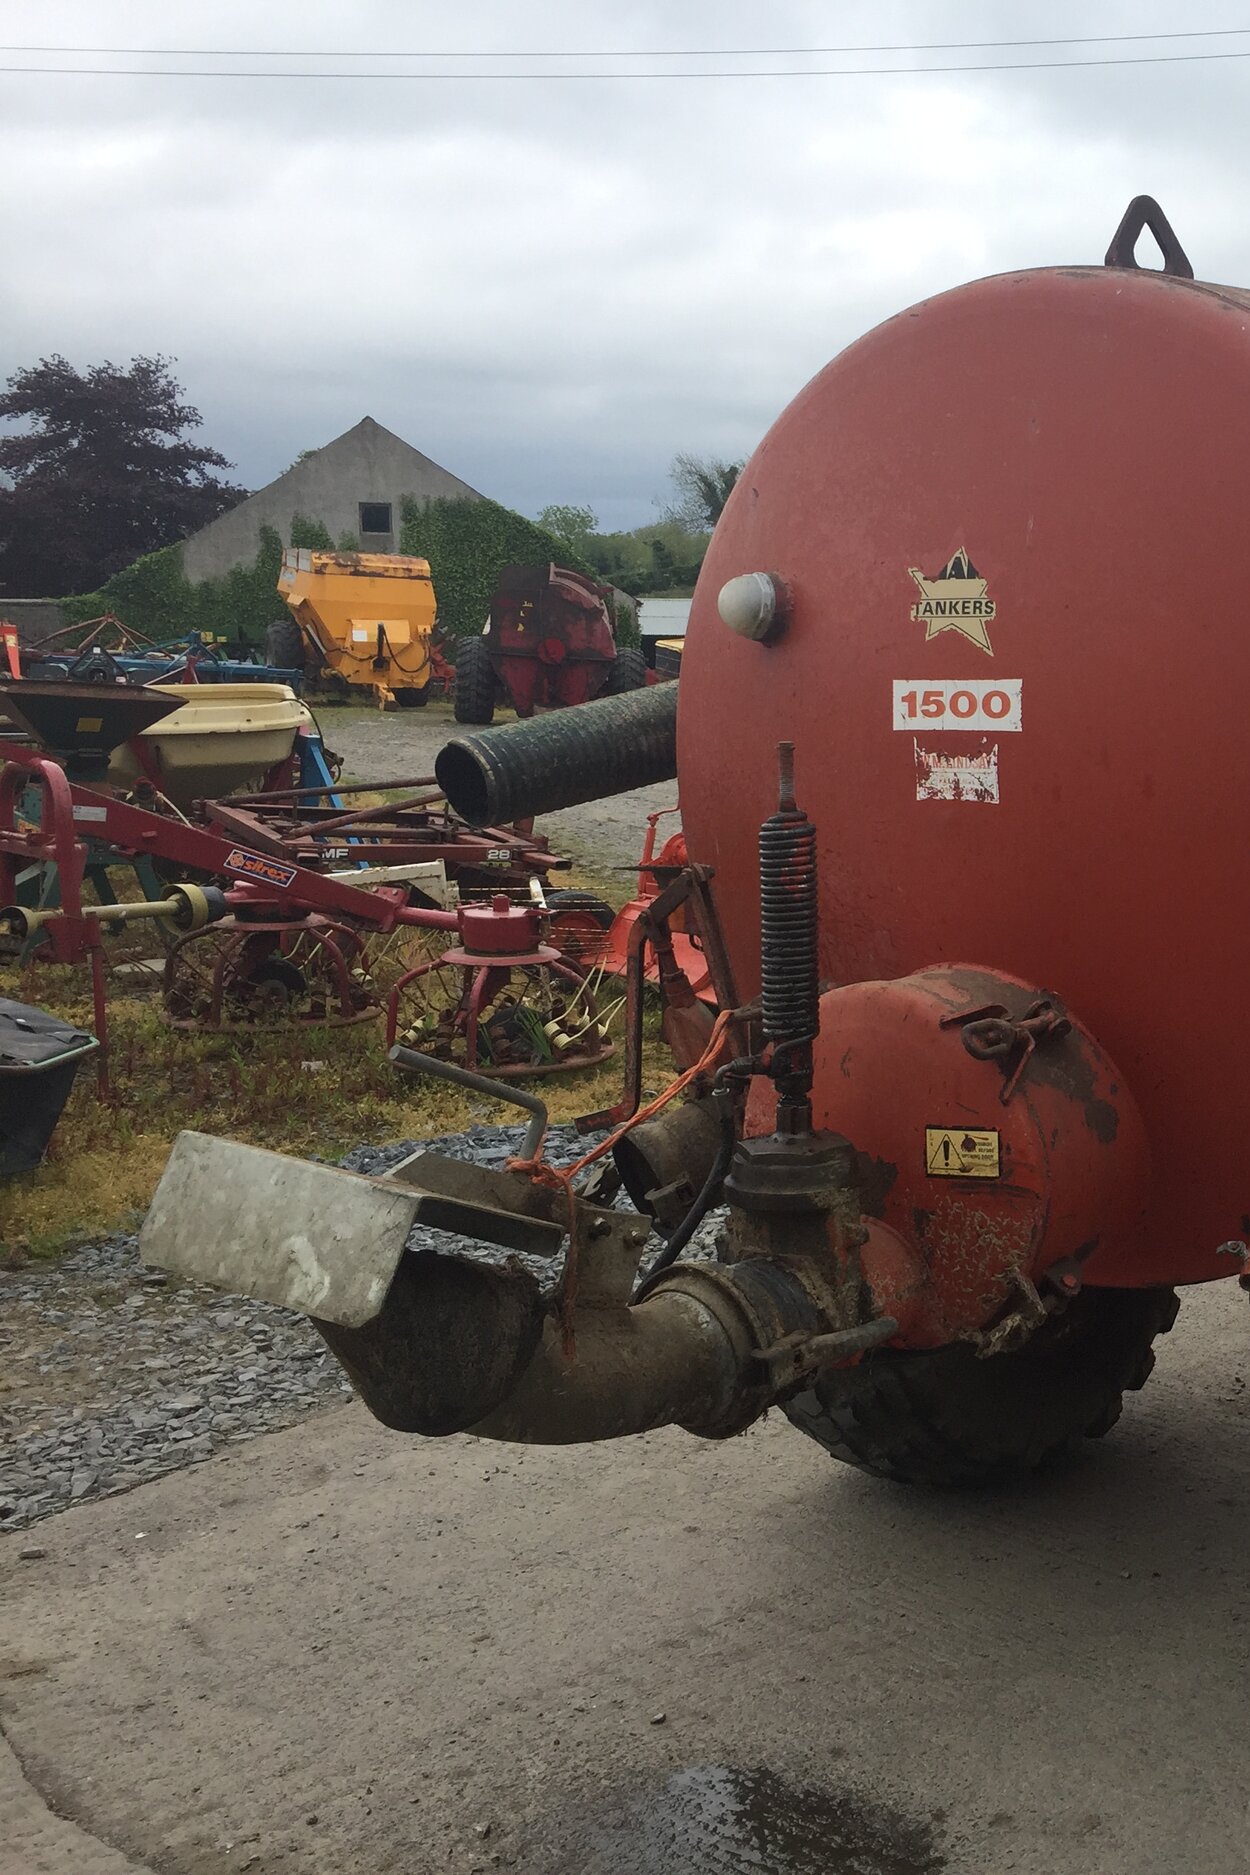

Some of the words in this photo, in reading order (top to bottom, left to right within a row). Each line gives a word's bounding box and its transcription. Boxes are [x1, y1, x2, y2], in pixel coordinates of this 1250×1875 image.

[901, 690, 1012, 719] 1500
[322, 848, 349, 859] MF
[487, 849, 510, 859] 28
[243, 860, 291, 881] sitrex
